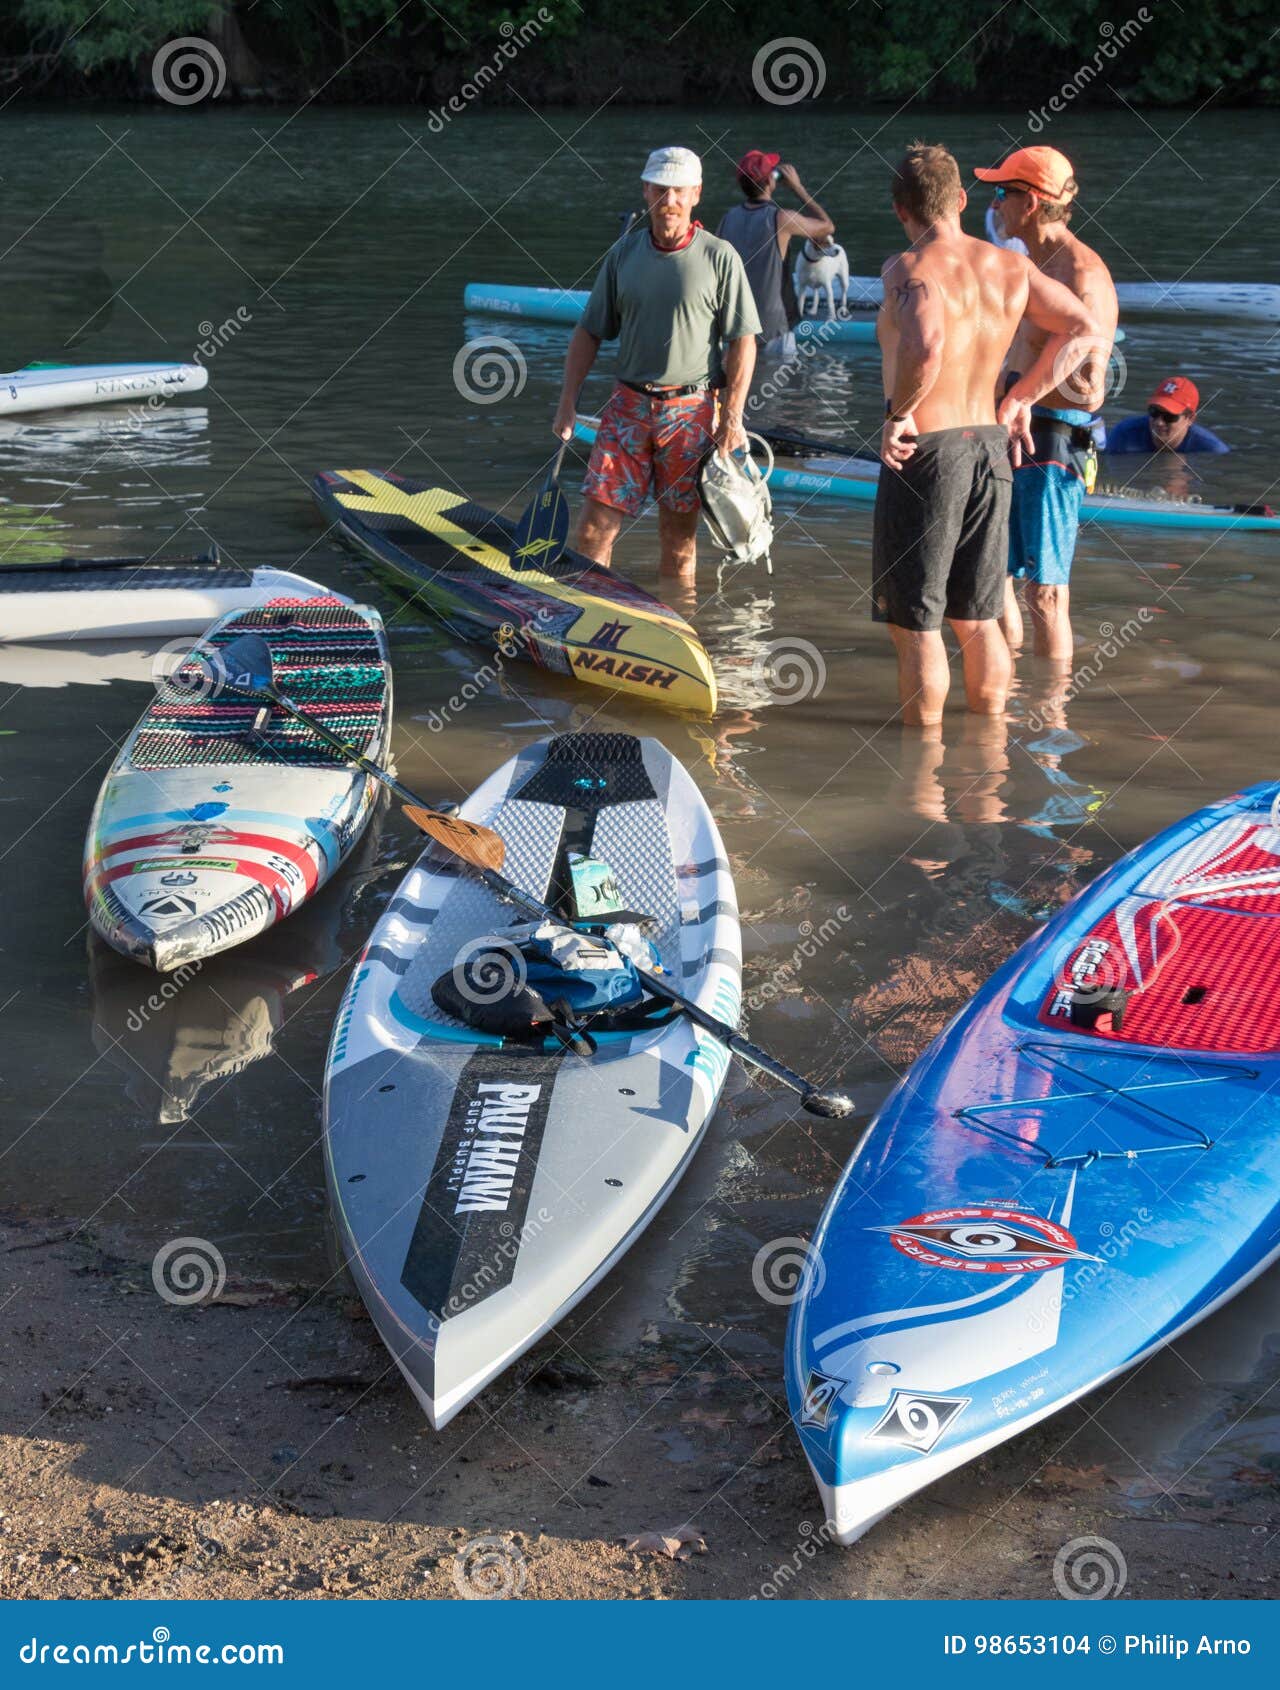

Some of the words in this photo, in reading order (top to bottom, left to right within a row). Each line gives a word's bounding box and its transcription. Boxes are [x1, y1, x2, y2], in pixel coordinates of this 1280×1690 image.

[95, 375, 157, 394] KINGS
[799, 474, 833, 489] BOGA
[573, 650, 679, 690] NAISH
[202, 883, 273, 943] INFINITY
[463, 1100, 482, 1133] SURF
[477, 1082, 542, 1136] PAU
[446, 1140, 471, 1192] SUPPLY
[454, 1139, 523, 1215] HANA
[923, 1209, 983, 1223] SURF
[896, 1237, 988, 1271] SPORT
